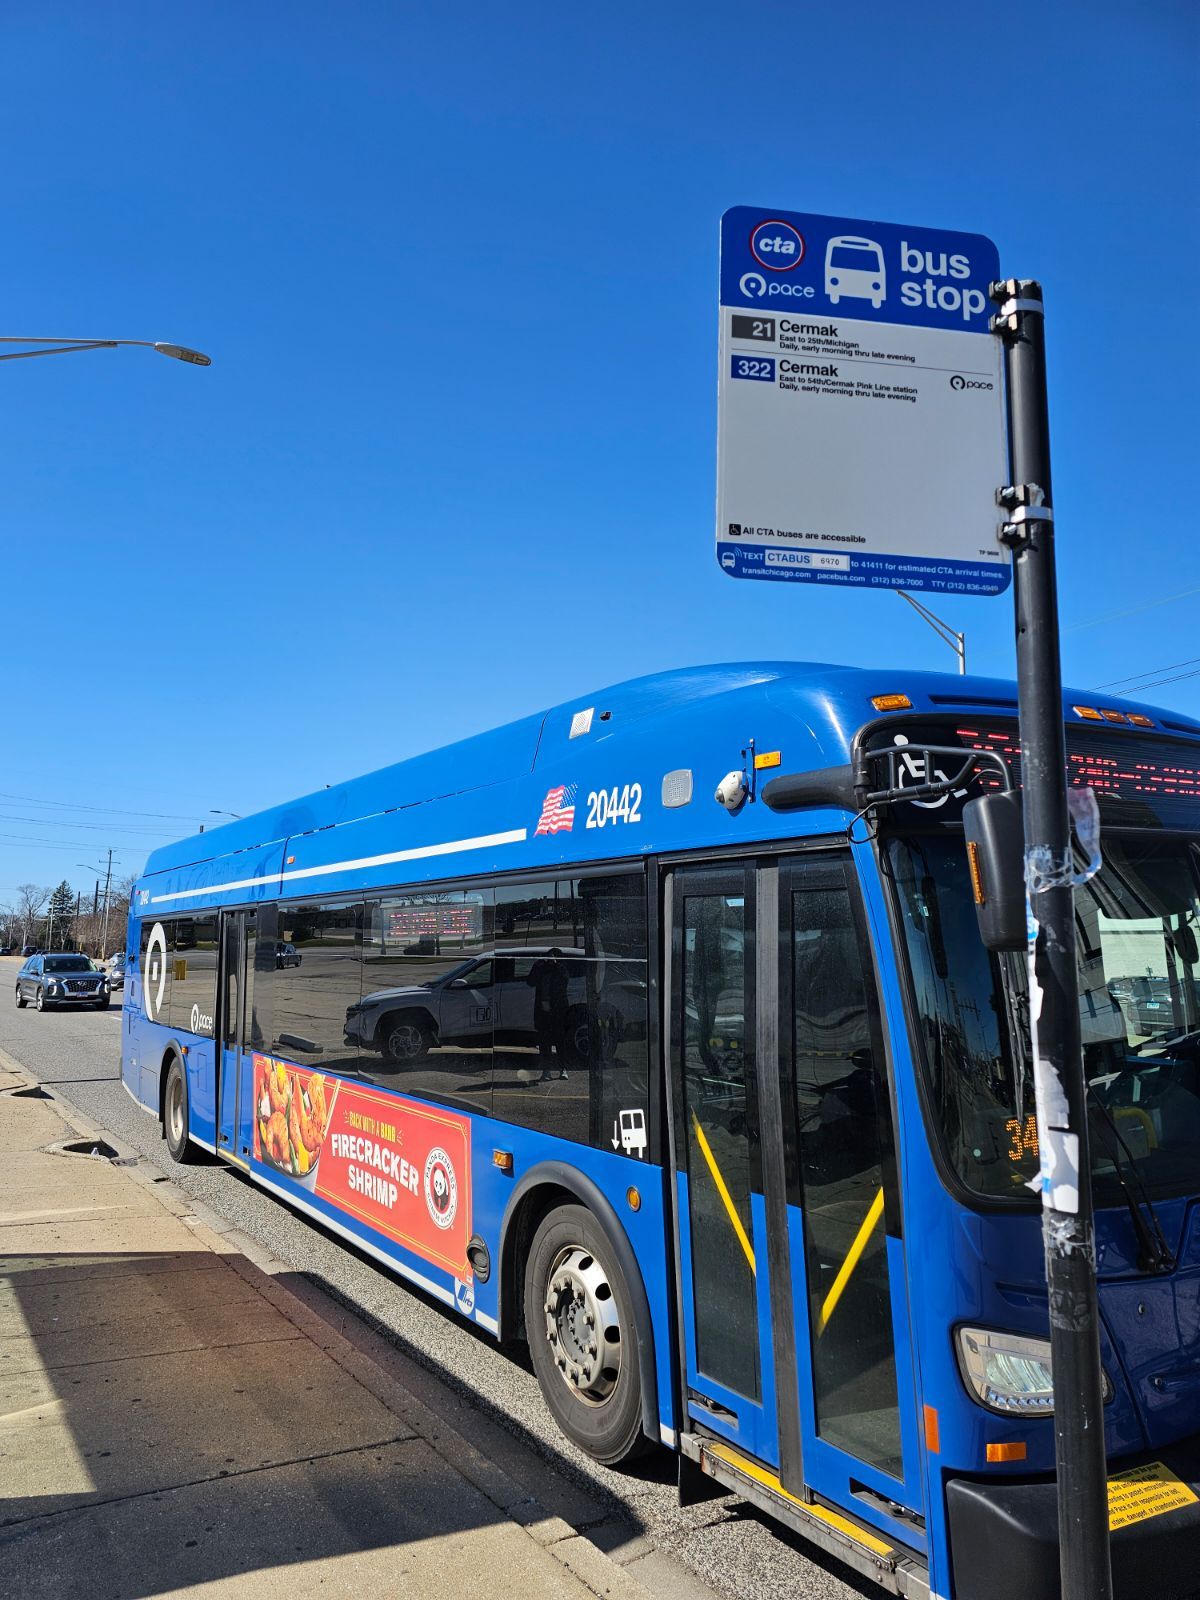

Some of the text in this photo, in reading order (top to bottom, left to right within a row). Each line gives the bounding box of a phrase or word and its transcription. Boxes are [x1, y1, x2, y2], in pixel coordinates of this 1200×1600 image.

[759, 236, 796, 255] cta
[901, 241, 971, 279] bus
[769, 281, 815, 298] pace
[900, 279, 986, 321] stop
[752, 321, 773, 338] 21
[779, 319, 839, 338] Cermak
[779, 334, 860, 349] East to 25th/Michigan
[779, 342, 916, 363] Daily, early morning thru late evening
[738, 360, 772, 379] 322
[779, 359, 839, 378] Cermak
[779, 374, 918, 394] East to 54th/Cermak Pink Line station
[779, 382, 917, 403] Daily, early morning thru late evening
[966, 379, 994, 391] pace
[743, 527, 755, 535] All
[757, 527, 775, 537] CTA
[777, 530, 803, 539] buses
[821, 533, 866, 544] accessible
[743, 552, 764, 561] TEXT
[767, 552, 811, 564] CTABUS
[850, 560, 859, 568] to
[861, 561, 883, 570] 41411
[885, 562, 896, 570] for
[898, 564, 937, 574] estimated
[937, 565, 954, 575] CTA
[955, 568, 980, 577] arrival
[981, 570, 1005, 579] times.
[742, 567, 812, 579] transitchicago.com
[817, 573, 866, 583] pacebus.com
[871, 576, 890, 585] (312)
[891, 578, 924, 587] 836-7000
[931, 580, 946, 588] TTY
[947, 581, 965, 590] (312)
[585, 782, 642, 829] 20442
[331, 1133, 420, 1197] FIRECRACKER
[347, 1164, 398, 1210] SHRIMP
